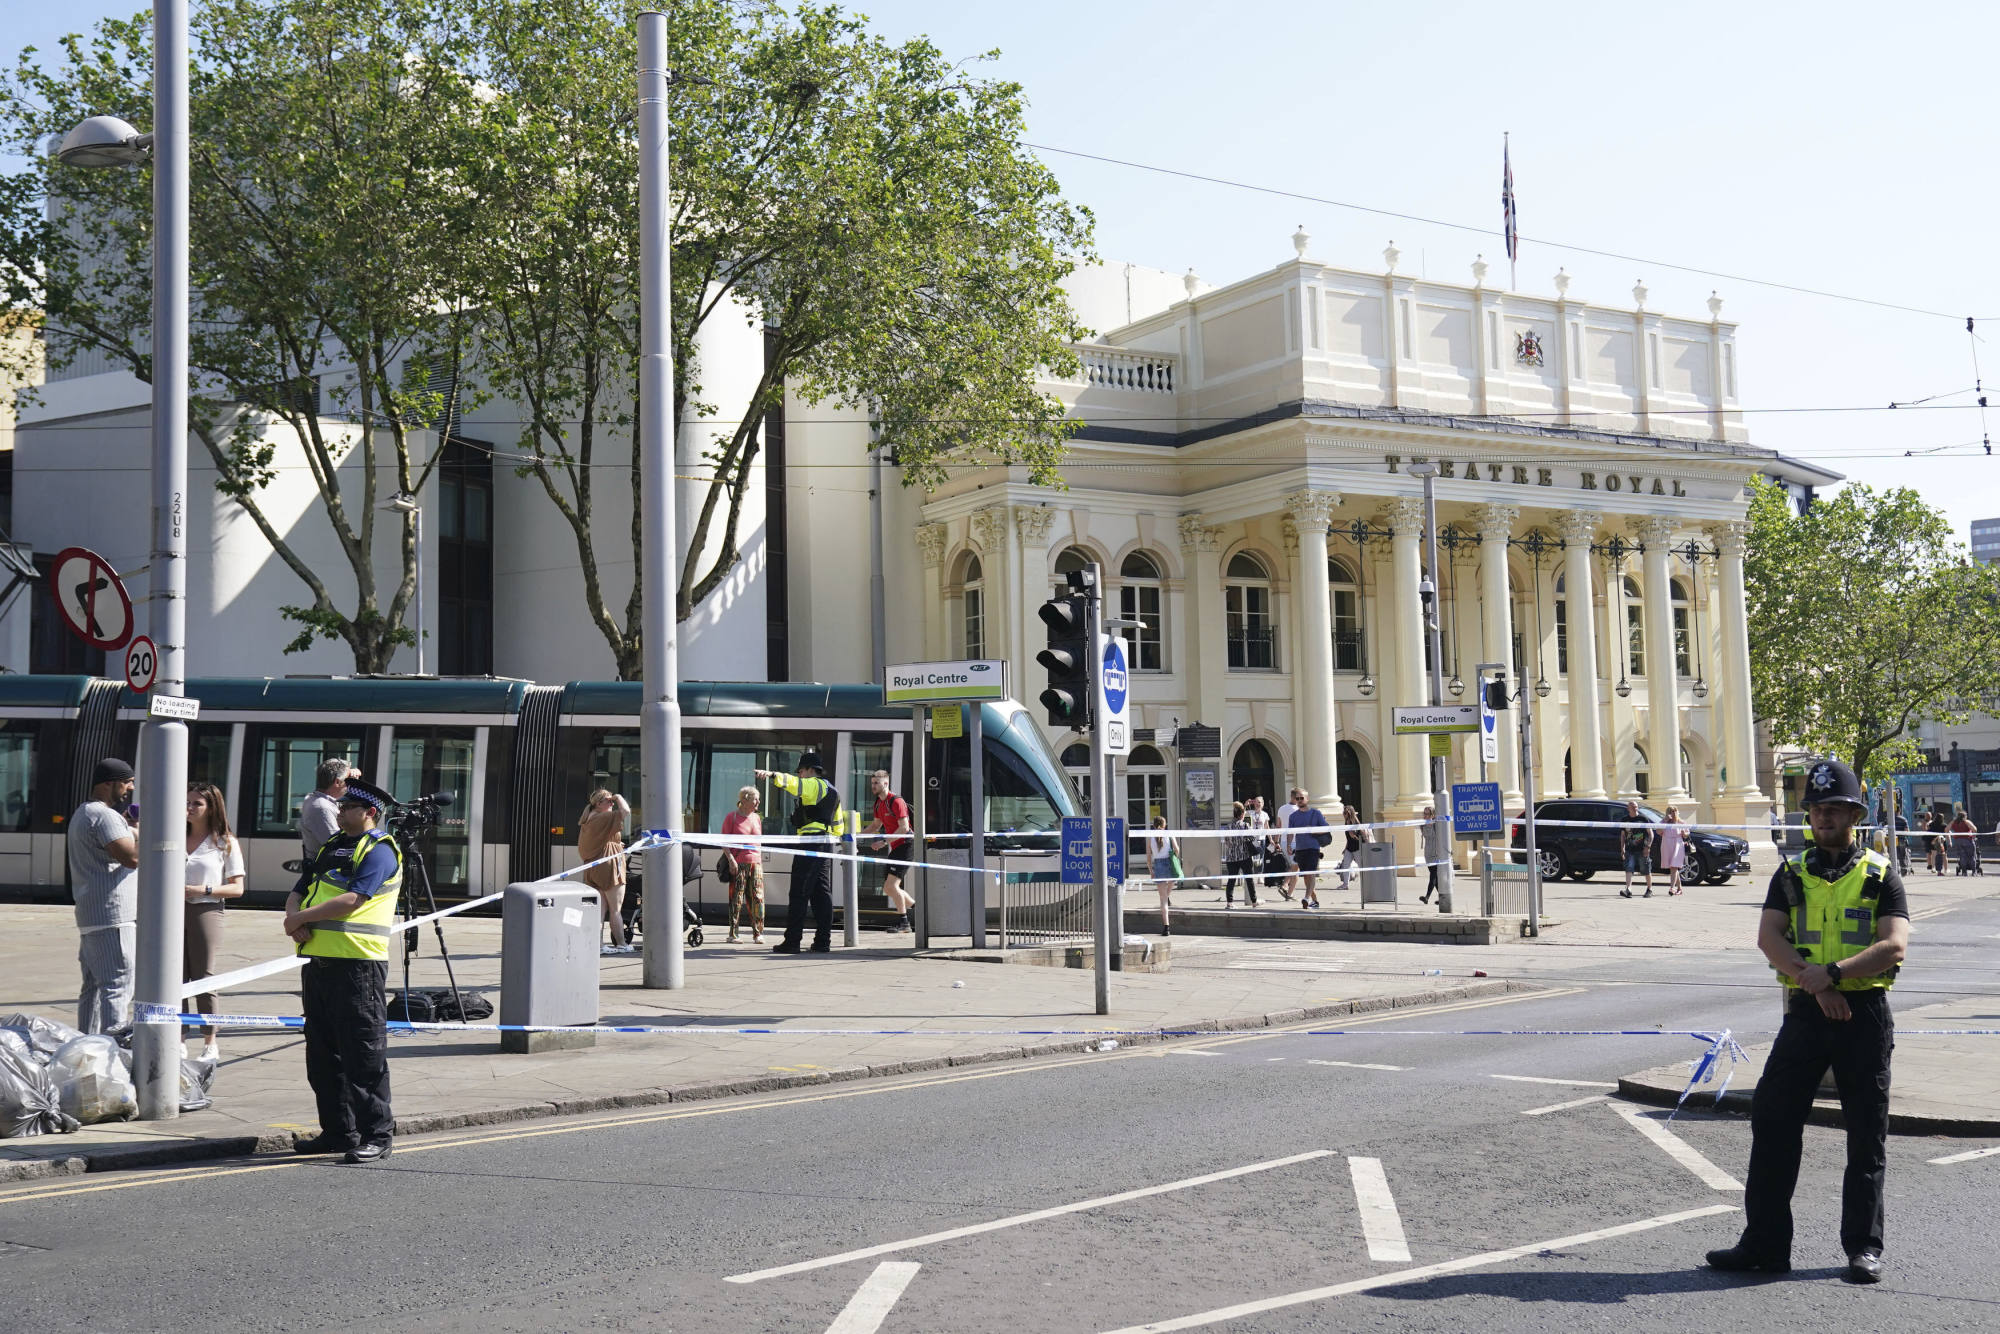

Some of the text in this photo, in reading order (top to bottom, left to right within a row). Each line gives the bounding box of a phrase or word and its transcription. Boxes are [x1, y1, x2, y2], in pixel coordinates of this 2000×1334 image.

[1581, 472, 1686, 497] ROYAL
[130, 652, 152, 677] 20
[894, 673, 968, 687] Royal Centre
[156, 698, 196, 710] No loading
[180, 709, 196, 717] time
[1400, 715, 1456, 725] Royal Centre
[1111, 728, 1121, 743] Only
[1458, 785, 1493, 793] TRAMWAY
[1069, 821, 1117, 830] TRAAY
[1065, 861, 1091, 870] LOOK
[1080, 871, 1094, 880] WA
